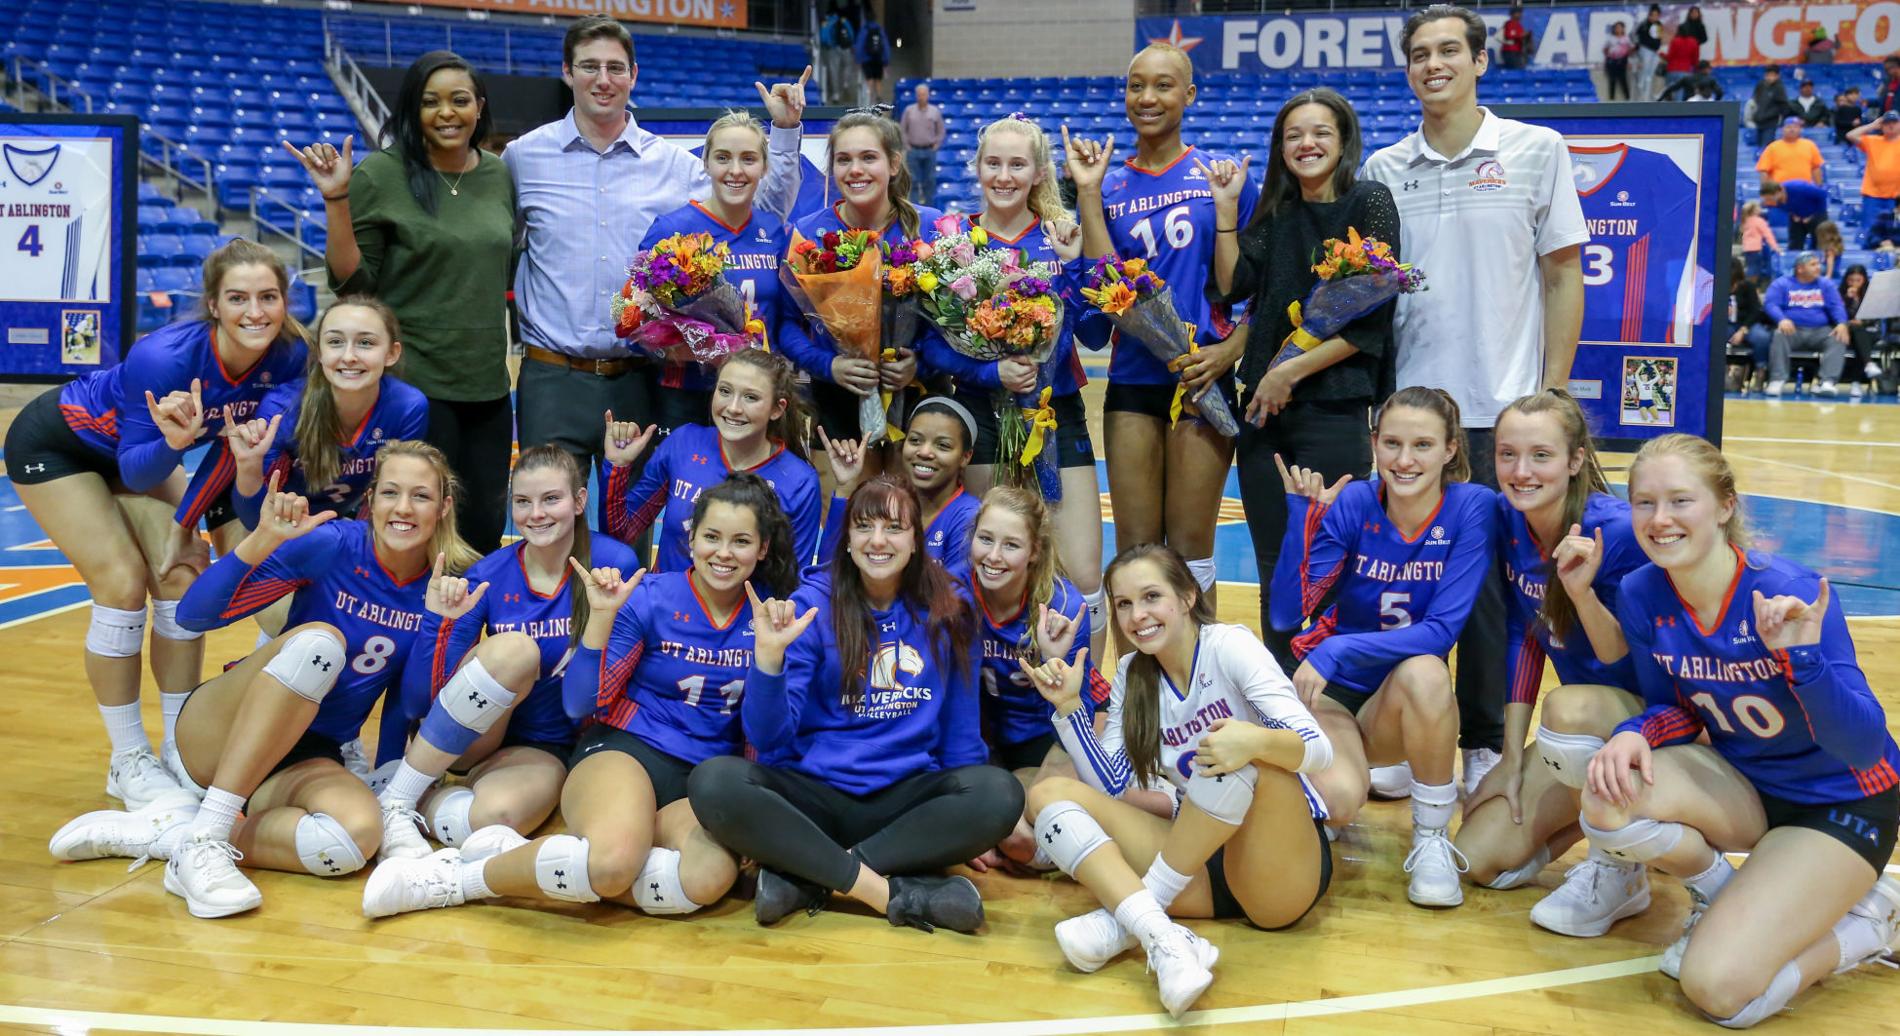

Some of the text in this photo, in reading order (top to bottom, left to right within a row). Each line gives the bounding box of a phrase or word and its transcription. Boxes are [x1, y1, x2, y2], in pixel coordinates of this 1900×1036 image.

[8, 204, 70, 217] ARLINGTON
[1109, 189, 1212, 220] UT ARLINGTON
[17, 225, 43, 257] 4
[1129, 205, 1194, 259] 16
[724, 254, 778, 270] RLINGTON
[675, 479, 693, 500] UT
[335, 591, 423, 632] UT ARLINGT
[1380, 592, 1412, 630] 5
[352, 635, 396, 674] 8
[661, 641, 753, 668] UT ARLINGT
[1680, 656, 1783, 681] ARLINGTON
[677, 675, 745, 715] 11
[1160, 698, 1233, 747] ARLIGTON
[1690, 692, 1785, 738] 10
[1828, 808, 1879, 848] UTA
